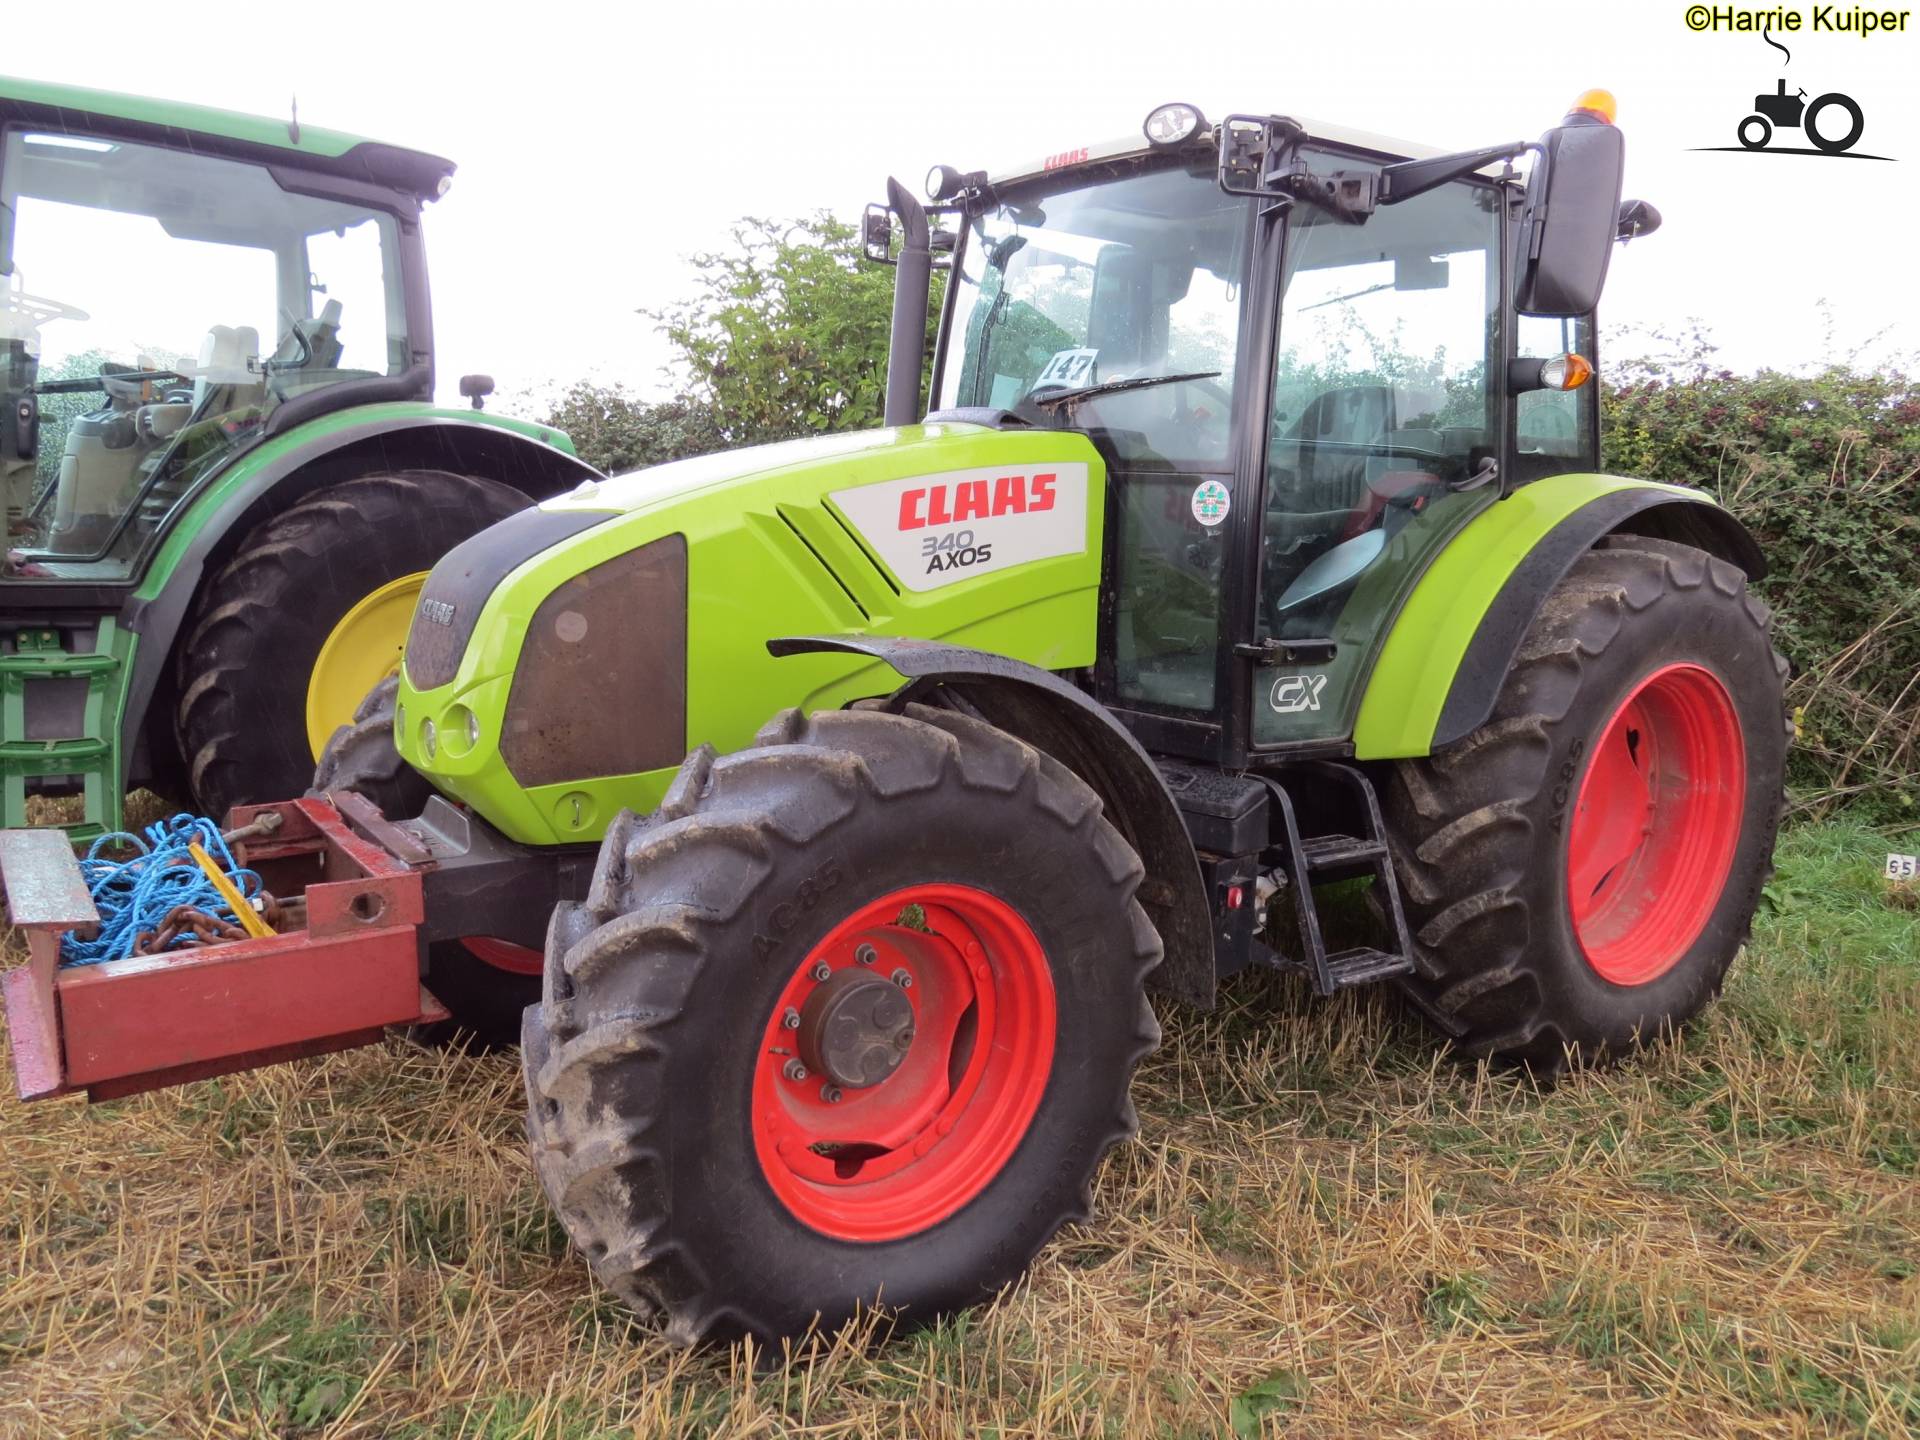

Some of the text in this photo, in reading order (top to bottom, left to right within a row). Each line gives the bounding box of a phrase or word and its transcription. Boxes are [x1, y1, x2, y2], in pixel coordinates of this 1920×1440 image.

[1042, 355, 1093, 381] 147
[898, 473, 1057, 531] CLAAS
[921, 530, 974, 557] 340
[926, 544, 992, 575] AXOS
[1269, 674, 1328, 713] CX
[1889, 860, 1912, 876] 65
